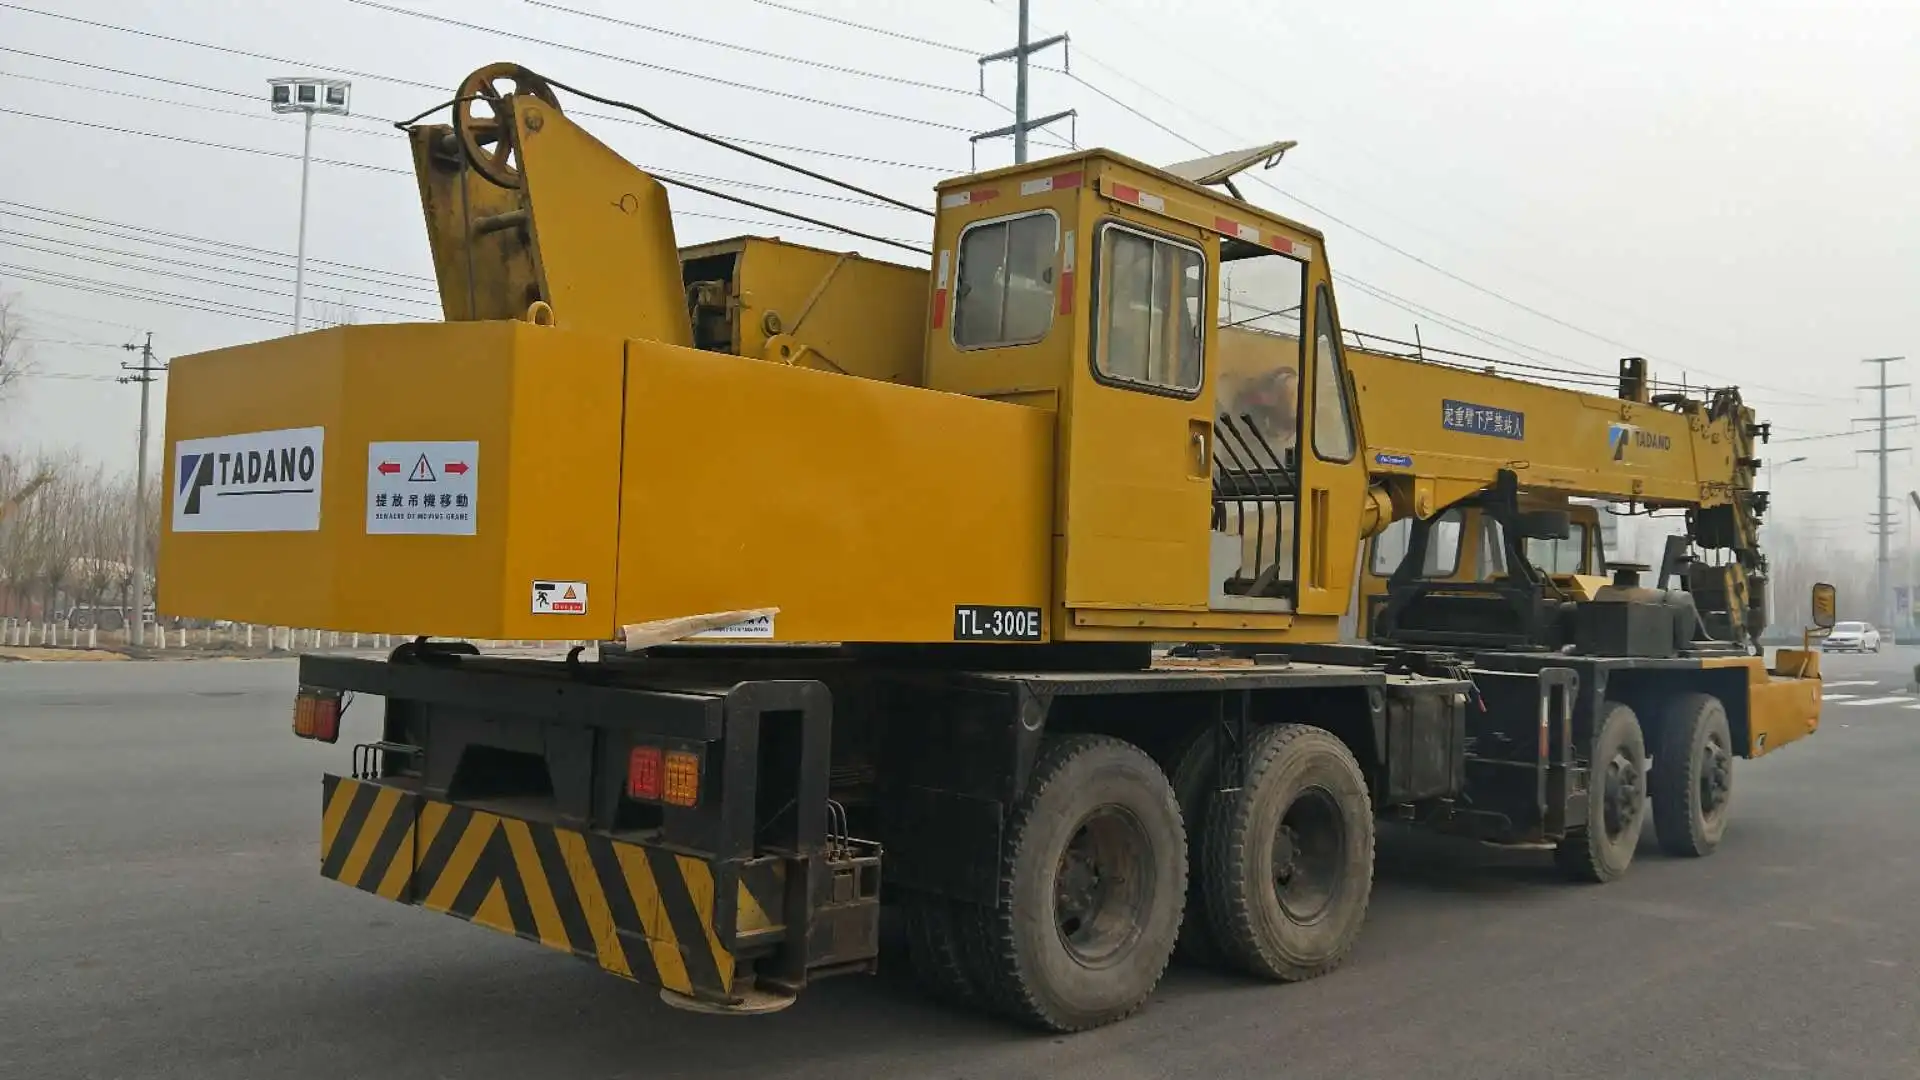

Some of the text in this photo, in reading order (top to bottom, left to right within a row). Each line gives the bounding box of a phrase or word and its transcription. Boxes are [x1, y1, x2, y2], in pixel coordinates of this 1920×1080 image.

[1443, 403, 1522, 437] 起重臂下严禁站人
[1635, 430, 1671, 451] TADANO
[219, 445, 315, 485] TADANO
[958, 609, 1038, 636] TL-300E
